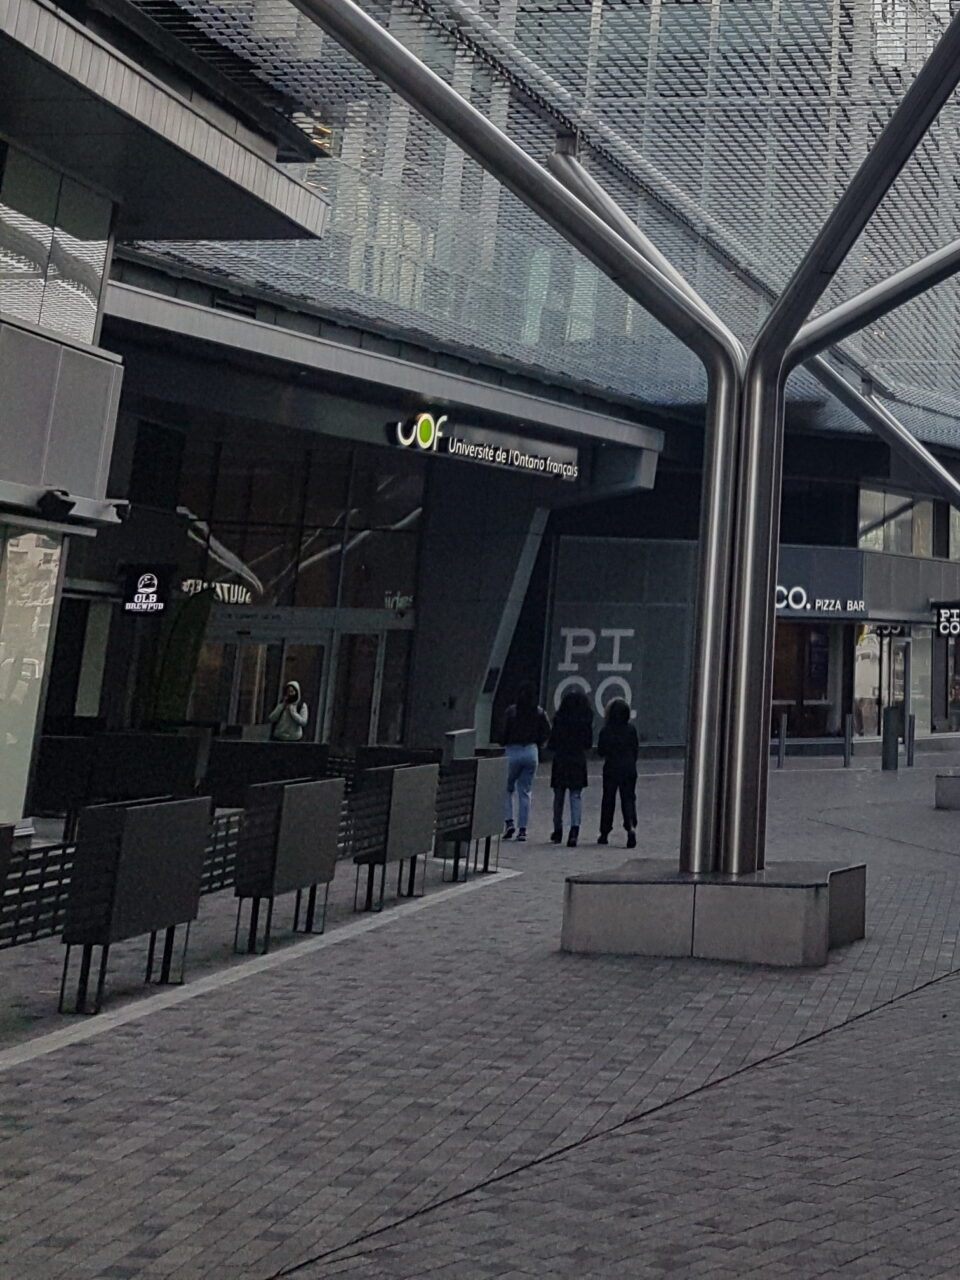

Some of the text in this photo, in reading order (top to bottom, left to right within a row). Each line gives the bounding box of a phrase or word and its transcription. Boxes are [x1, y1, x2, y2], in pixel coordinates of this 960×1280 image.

[448, 436, 578, 478] Université de l'Ontario français
[815, 599, 841, 611] PIZZA
[847, 600, 865, 611] BAR
[940, 609, 960, 622] PI
[558, 627, 635, 671] PI
